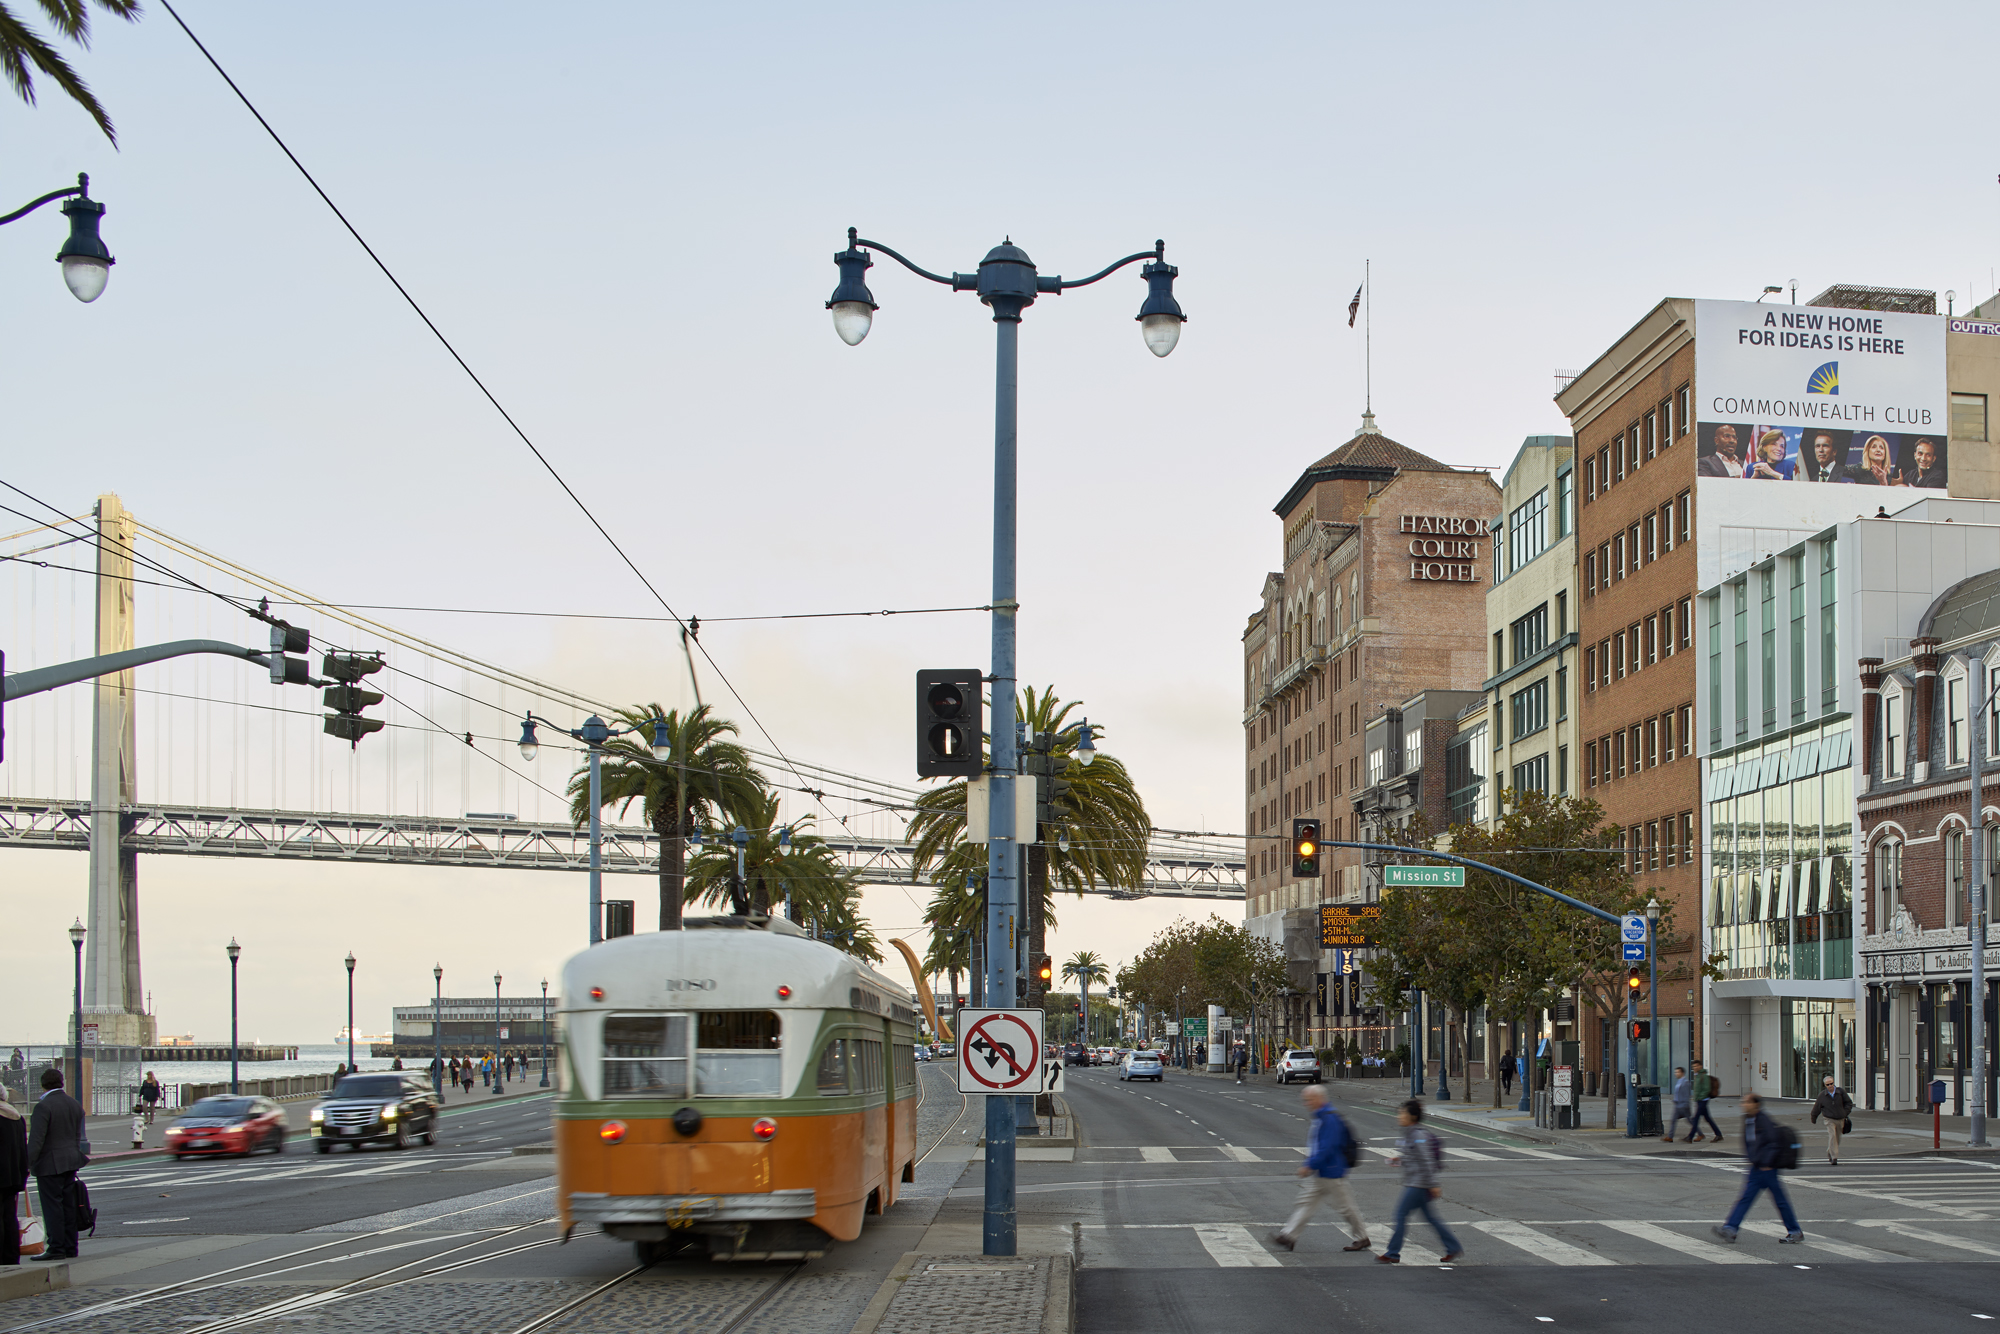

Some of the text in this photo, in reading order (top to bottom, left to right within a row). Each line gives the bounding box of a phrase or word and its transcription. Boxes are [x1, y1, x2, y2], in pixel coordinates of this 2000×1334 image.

[1764, 312, 1883, 334] A NEW HOME
[1738, 329, 1904, 355] FOR IDEAS IS HERE
[1713, 397, 1932, 425] COMMONWEALTH CLUB
[1400, 515, 1491, 536] HARBOR
[1409, 539, 1482, 558] COURT
[1410, 562, 1482, 582] HOTEL
[1393, 870, 1456, 882] Mission St
[1322, 907, 1382, 916] GARAGE SPAC
[1327, 918, 1360, 926] MOSCON
[1327, 935, 1349, 944] UNION
[1342, 948, 1353, 974] Y'S
[1935, 954, 1946, 969] The
[1983, 951, 2000, 965] uildi
